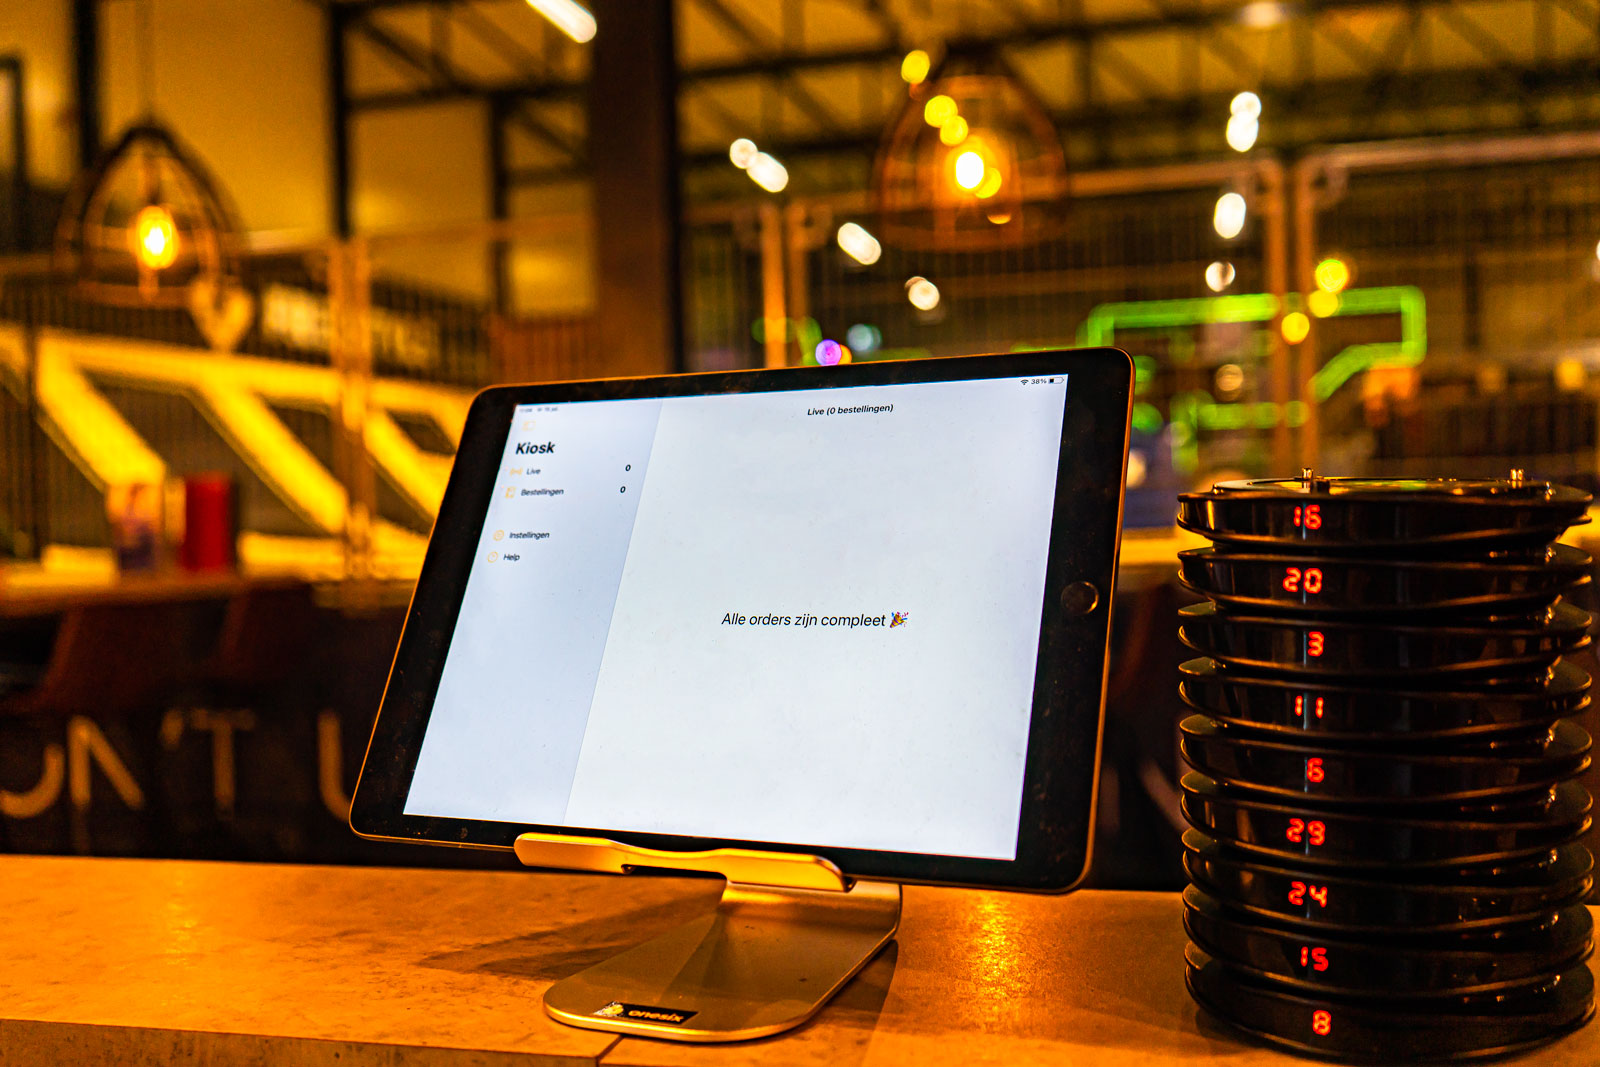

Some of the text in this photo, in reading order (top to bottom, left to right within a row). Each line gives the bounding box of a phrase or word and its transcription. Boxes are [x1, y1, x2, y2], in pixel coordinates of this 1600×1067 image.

[807, 403, 894, 416] Live (0 bestellingen)
[515, 441, 556, 455] Kiosk
[526, 467, 541, 475] Live
[625, 464, 632, 472] 0
[520, 488, 564, 496] Bestellingen
[619, 485, 627, 494] 0
[1293, 504, 1322, 530] 16
[509, 531, 550, 540] Instellingen
[503, 553, 520, 562] Help
[1282, 567, 1323, 594] 20
[721, 613, 886, 628] Alle orders zijn compleet
[1307, 631, 1325, 657] 3
[1294, 695, 1324, 719] 11
[1306, 757, 1325, 783] 6
[1285, 817, 1326, 846] 29
[1287, 881, 1328, 908] 24
[1300, 946, 1329, 972] 15
[628, 1010, 684, 1022] onesix
[1312, 1009, 1332, 1036] 8
